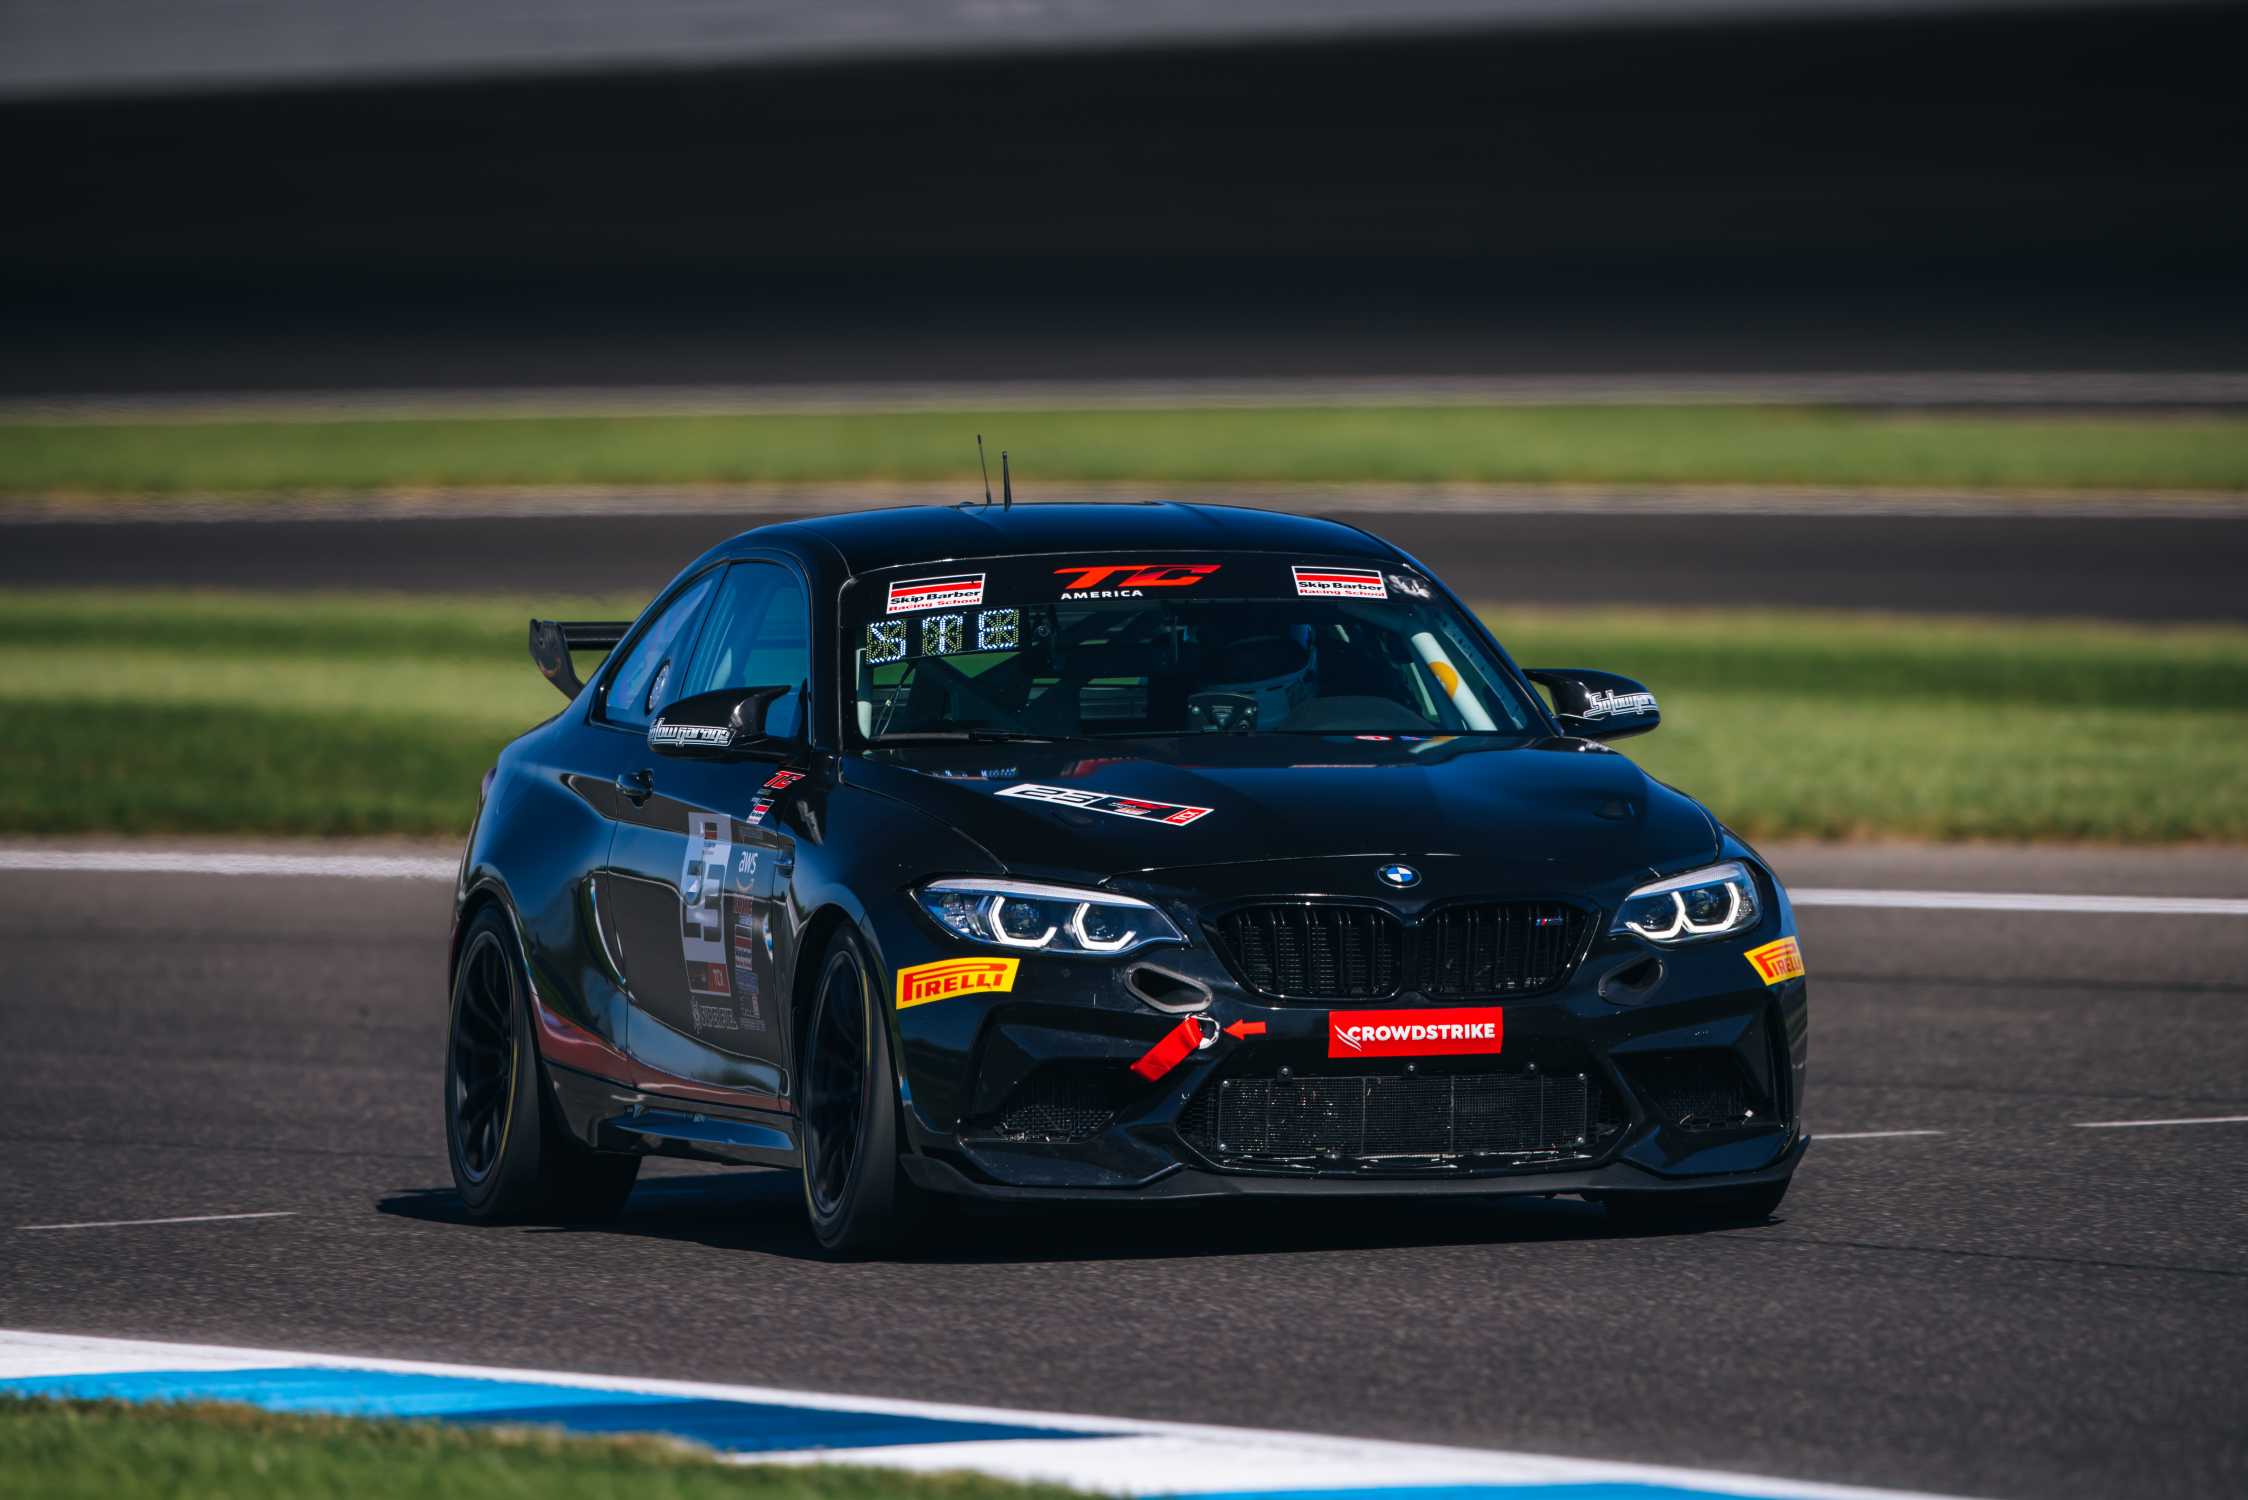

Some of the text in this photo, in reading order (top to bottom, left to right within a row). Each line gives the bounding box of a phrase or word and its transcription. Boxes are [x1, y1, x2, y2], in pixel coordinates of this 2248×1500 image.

[1054, 564, 1222, 590] TC
[1299, 581, 1383, 591] Skip Barber
[1345, 589, 1385, 597] School
[890, 589, 981, 605] Skip Barber
[1060, 590, 1144, 600] AMERICA
[888, 597, 980, 611] Racing School
[738, 850, 759, 875] aws
[902, 962, 1008, 1002] PIRELLI
[1346, 1022, 1497, 1043] CROWDSTRIKE
